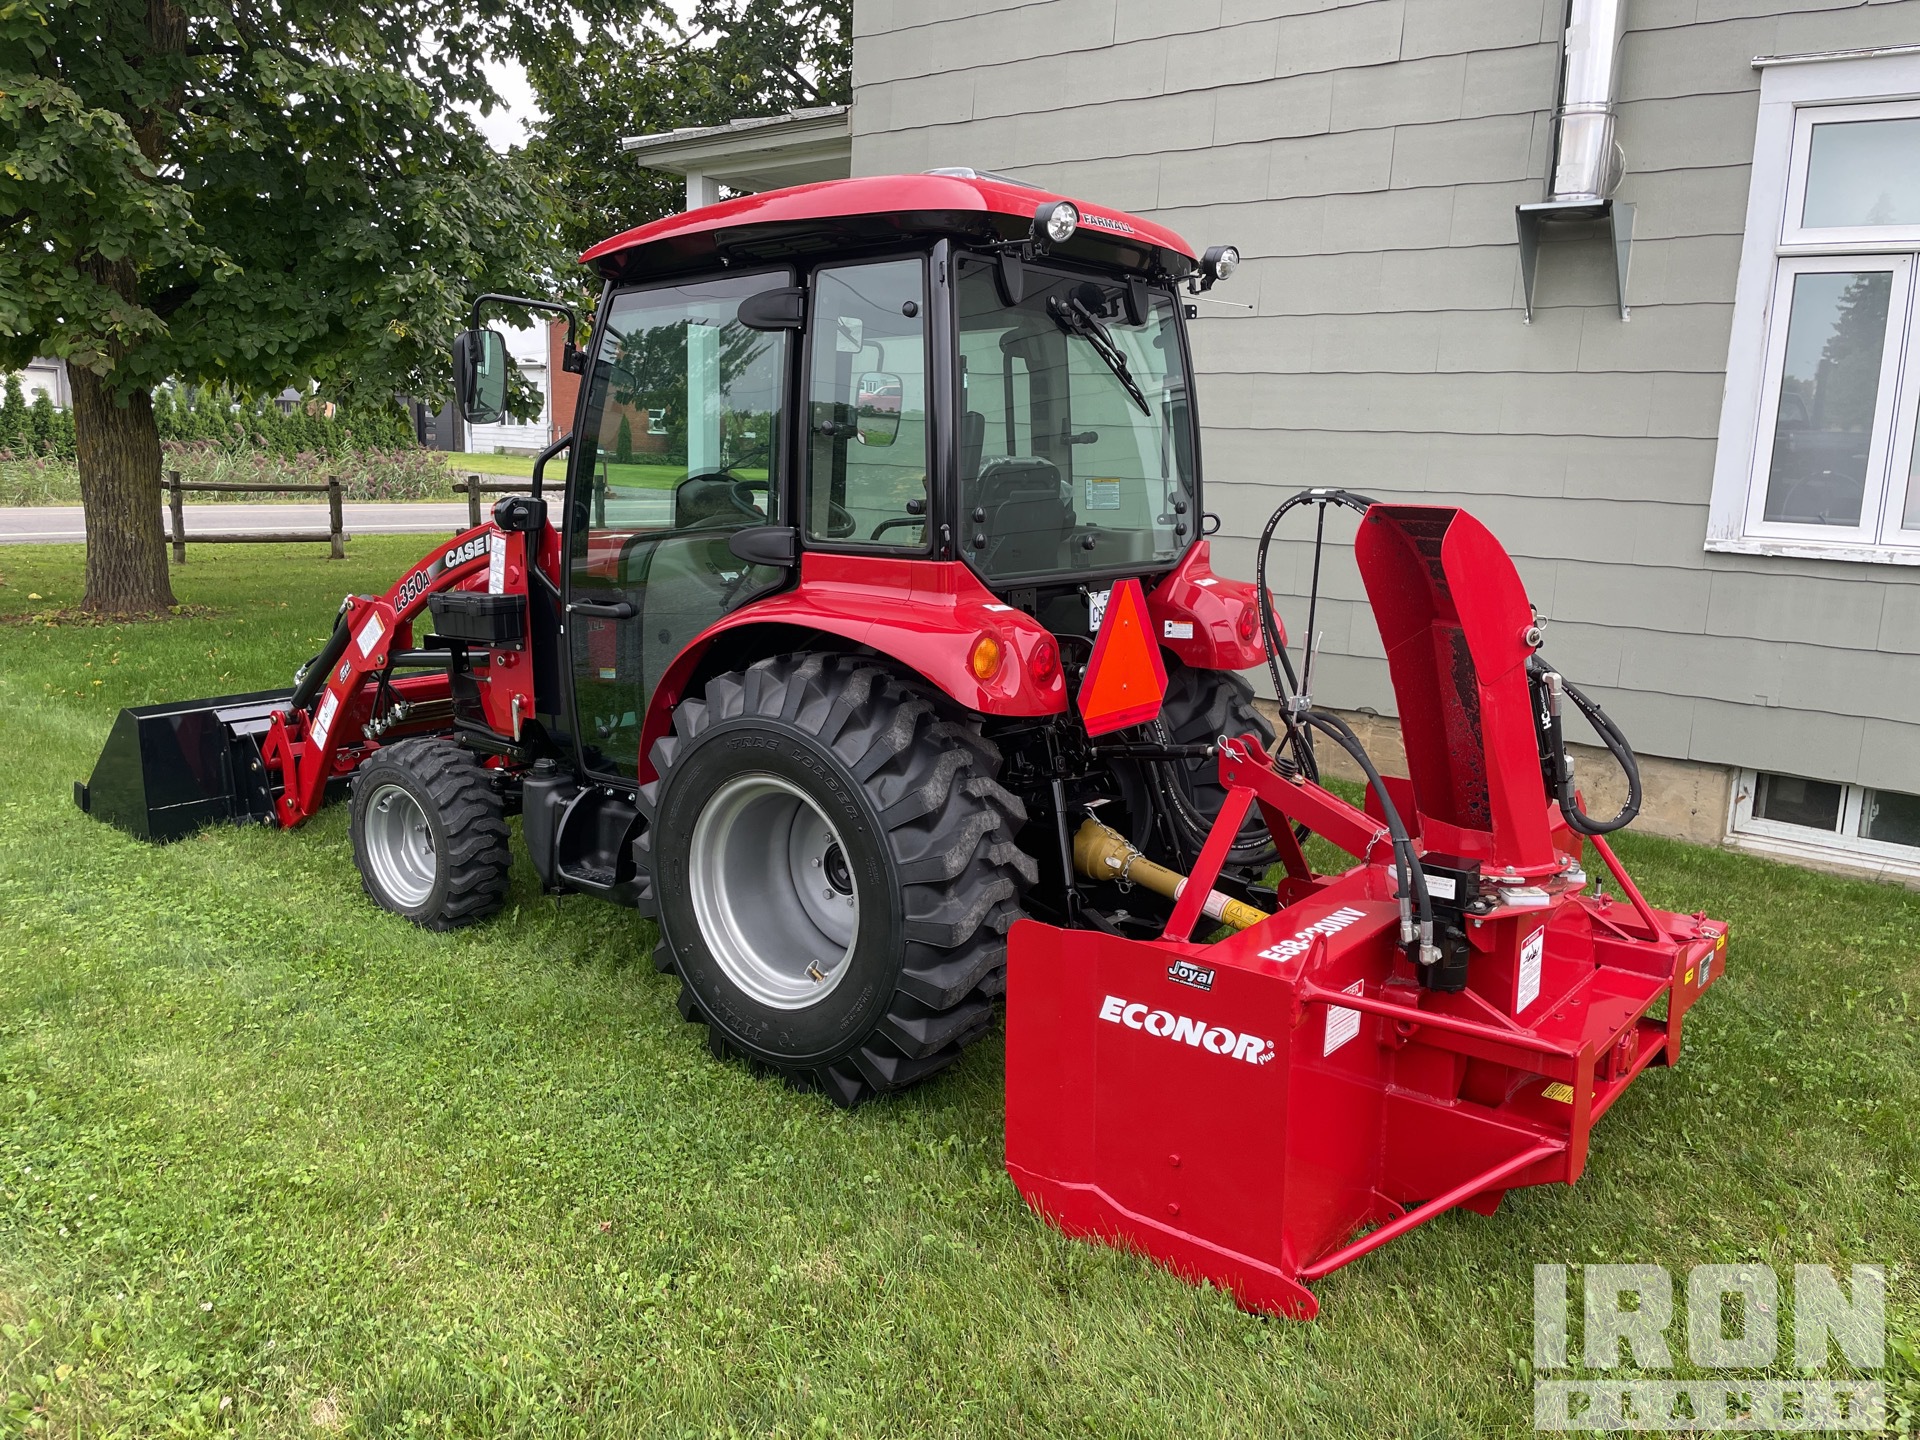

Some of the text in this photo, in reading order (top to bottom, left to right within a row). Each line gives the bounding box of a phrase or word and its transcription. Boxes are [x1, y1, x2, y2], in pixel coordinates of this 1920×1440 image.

[1083, 214, 1134, 233] FARMALL
[394, 570, 430, 615] L350A
[730, 737, 858, 820] TRAC LOADER
[1168, 960, 1215, 986] Joyal
[1099, 995, 1265, 1064] ECONOR
[1258, 1050, 1275, 1066] Plus
